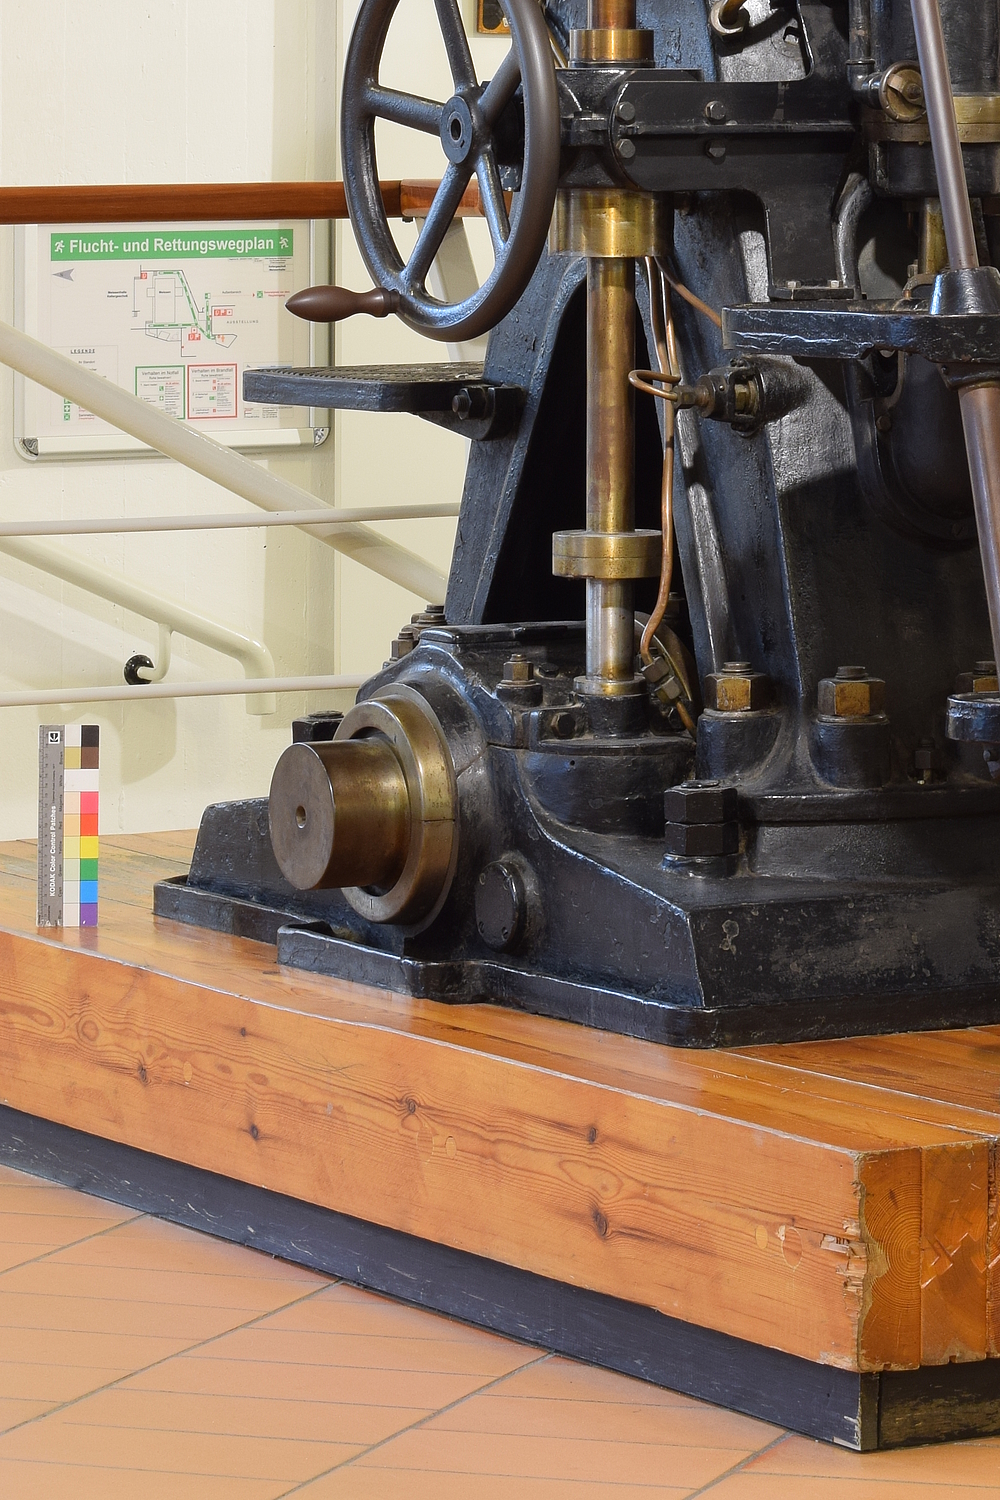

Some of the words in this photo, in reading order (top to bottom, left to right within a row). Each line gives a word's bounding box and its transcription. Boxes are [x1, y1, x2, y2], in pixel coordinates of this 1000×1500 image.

[69, 239, 119, 253] Flucht-
[122, 238, 150, 252] und
[153, 237, 274, 254] Rettungswegplan
